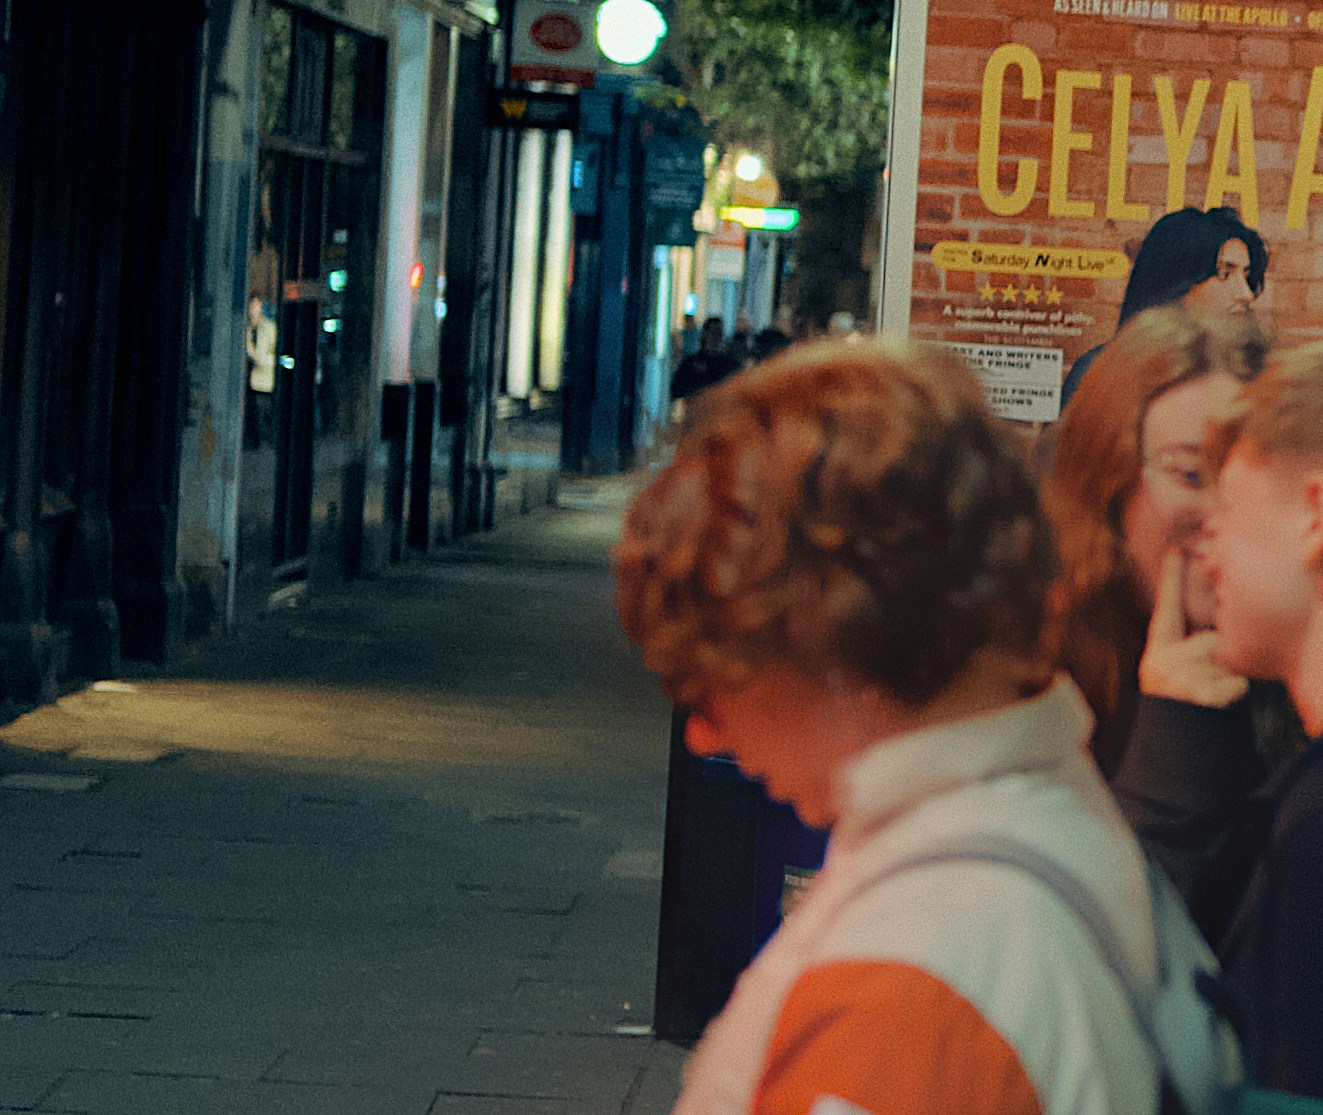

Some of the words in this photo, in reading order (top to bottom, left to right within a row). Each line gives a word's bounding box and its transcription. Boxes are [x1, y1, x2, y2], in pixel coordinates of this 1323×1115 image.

[977, 43, 1260, 229] CELYA
[972, 250, 1030, 269] Saturday
[1035, 254, 1073, 269] Night
[977, 349, 1004, 357] AND
[1006, 351, 1059, 361] WRITERS
[988, 360, 1032, 369] FRINGE
